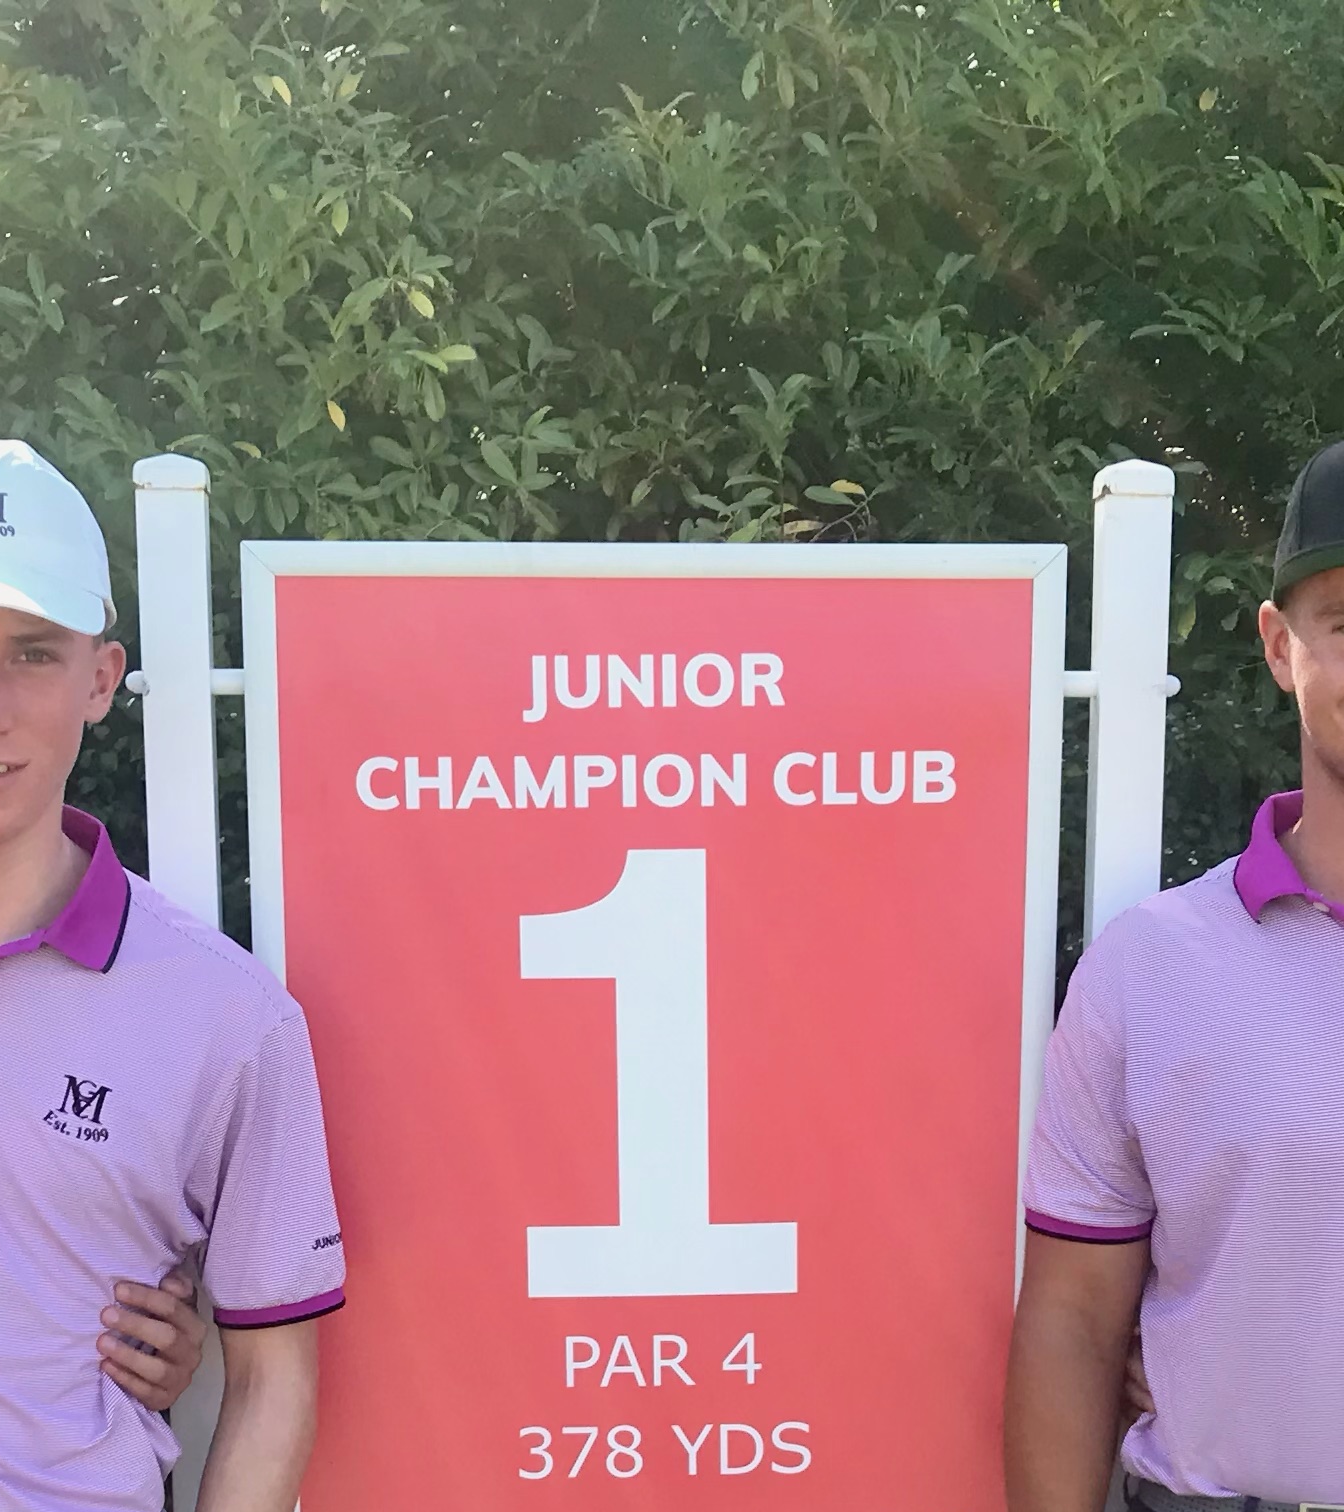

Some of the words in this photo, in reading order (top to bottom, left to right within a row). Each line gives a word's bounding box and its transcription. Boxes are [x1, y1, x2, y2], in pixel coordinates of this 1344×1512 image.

[523, 653, 785, 722] JUNIOR
[356, 754, 747, 810] CHAMPION
[773, 750, 957, 806] CLUB
[520, 849, 798, 1297] 1
[43, 1109, 70, 1136] Est.
[76, 1127, 109, 1142] 1909
[565, 1335, 696, 1388] PAR
[722, 1333, 762, 1385] 4
[518, 1425, 644, 1479] 378
[672, 1422, 812, 1476] YDS
